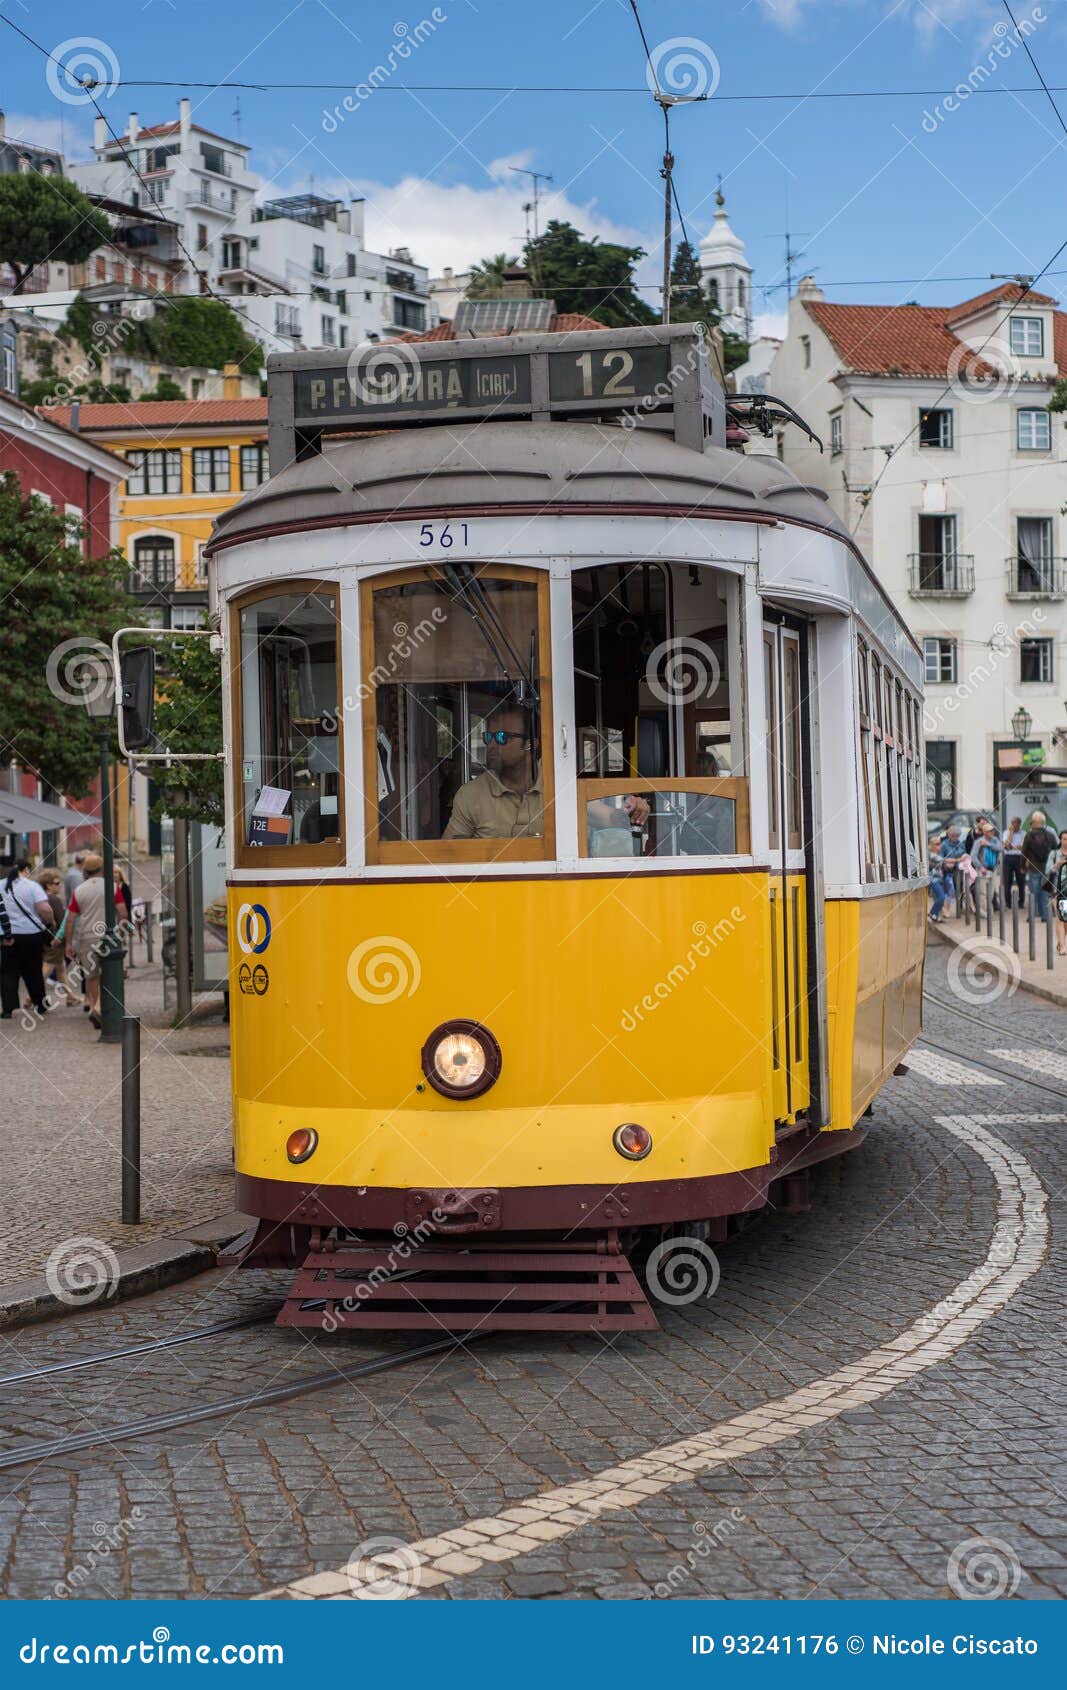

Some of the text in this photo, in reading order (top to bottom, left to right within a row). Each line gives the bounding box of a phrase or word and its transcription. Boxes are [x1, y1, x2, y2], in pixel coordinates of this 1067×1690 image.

[576, 350, 635, 396] 12
[419, 523, 467, 548] 561
[253, 820, 268, 831] 12E
